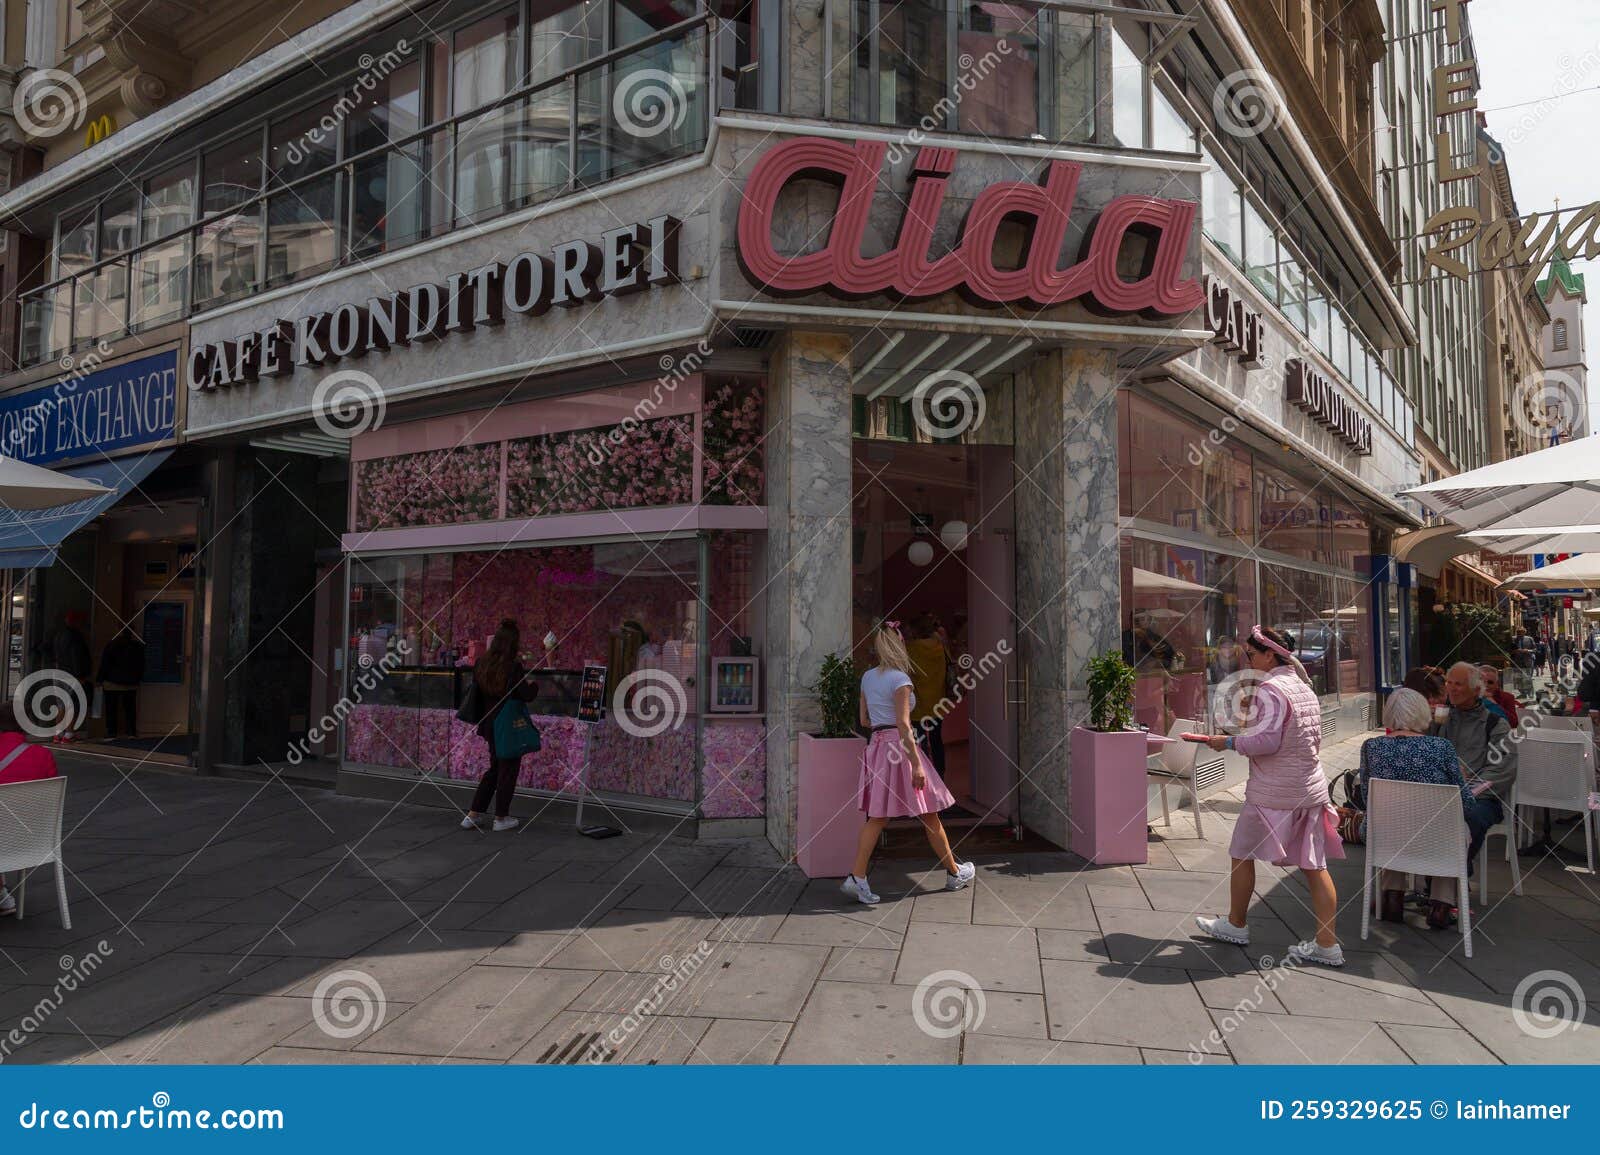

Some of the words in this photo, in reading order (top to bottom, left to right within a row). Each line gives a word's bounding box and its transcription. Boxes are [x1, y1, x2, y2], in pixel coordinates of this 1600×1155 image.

[297, 214, 671, 366] KONDITOREI
[0, 404, 50, 459] ONEY
[56, 368, 175, 452] EXCHANGE
